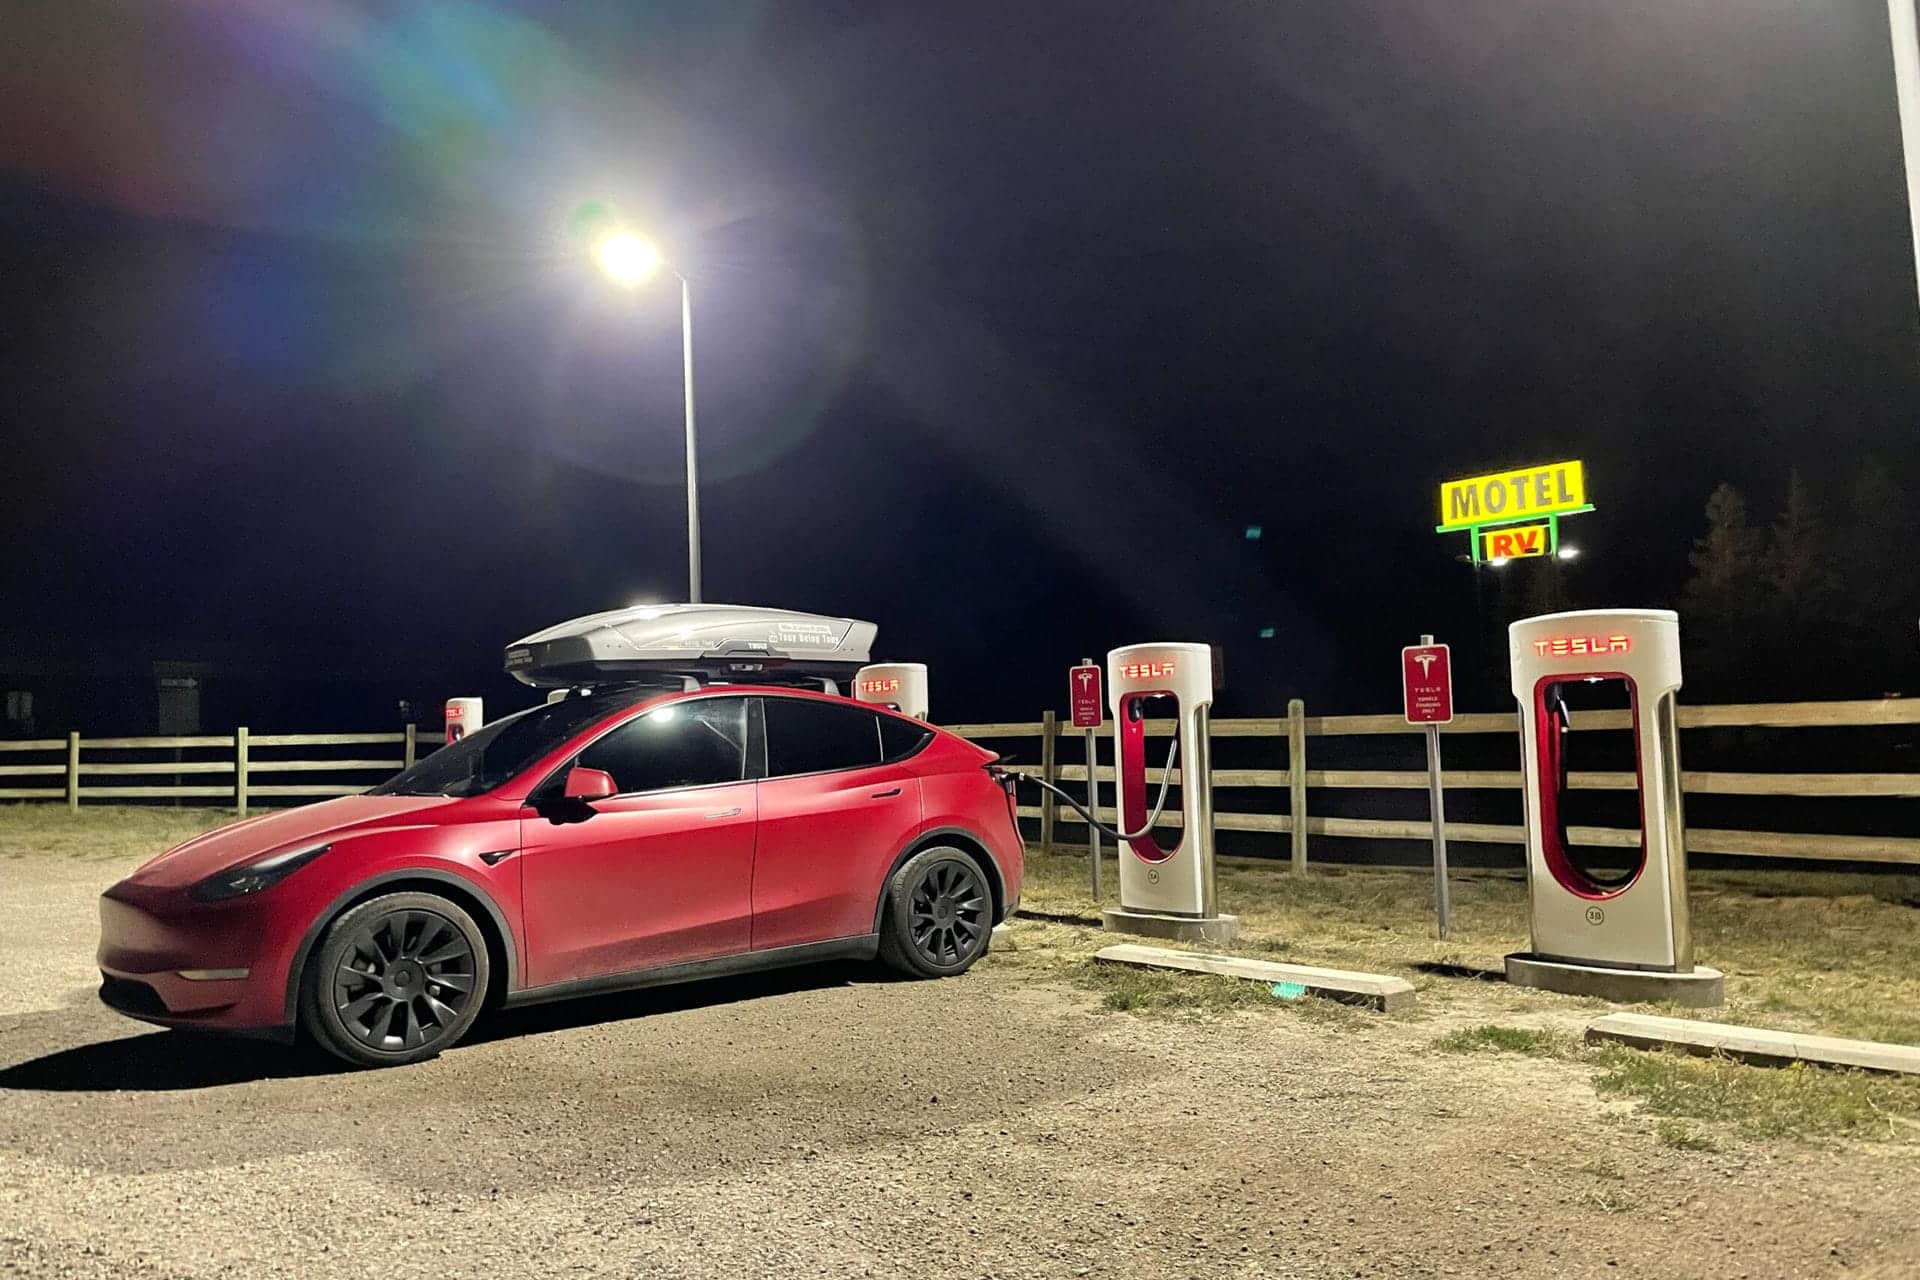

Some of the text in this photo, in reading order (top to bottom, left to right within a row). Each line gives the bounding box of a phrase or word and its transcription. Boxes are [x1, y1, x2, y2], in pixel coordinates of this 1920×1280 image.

[1450, 469, 1574, 519] MOTEL
[1493, 531, 1537, 558] RV
[1533, 636, 1628, 656] TESLA
[1119, 662, 1175, 679] TESLA
[862, 679, 898, 692] TESLA
